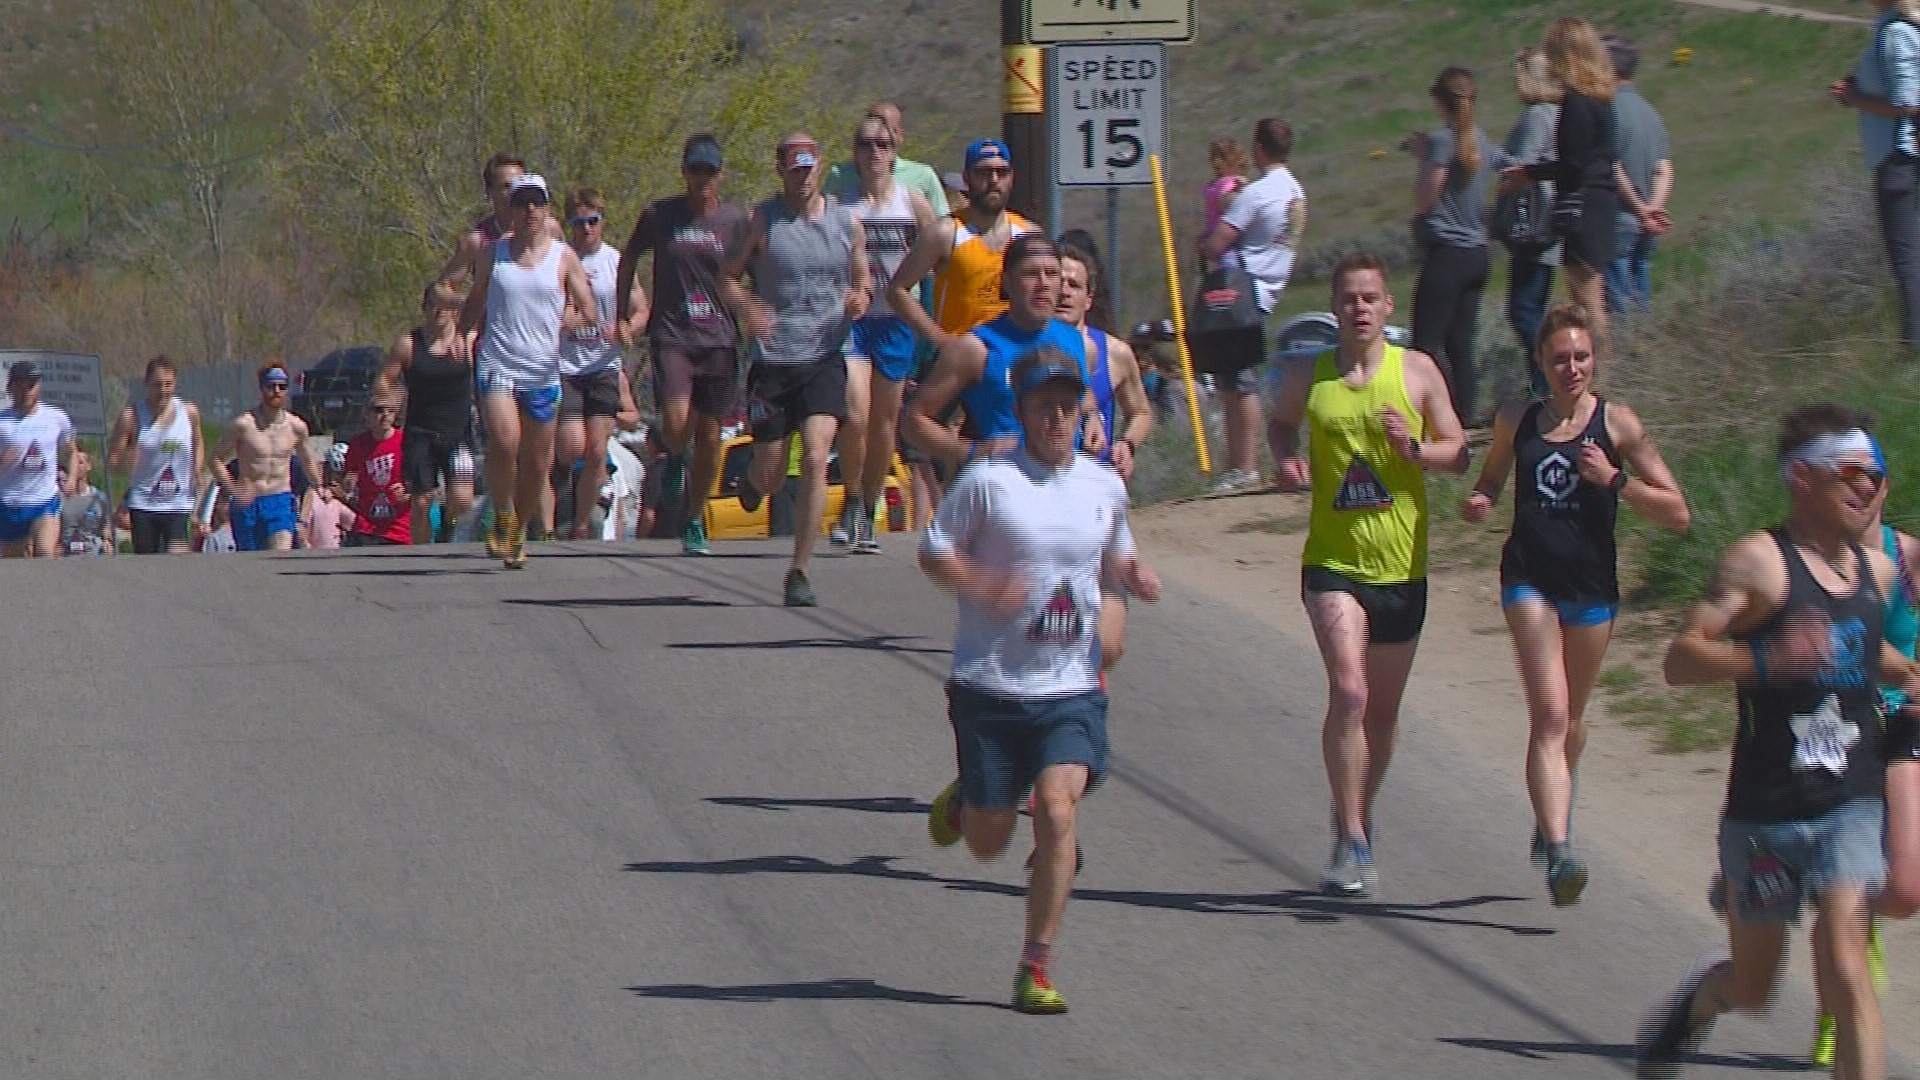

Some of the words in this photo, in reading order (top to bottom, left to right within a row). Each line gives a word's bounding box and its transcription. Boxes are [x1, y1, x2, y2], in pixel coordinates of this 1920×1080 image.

[1064, 60, 1157, 80] SPEED
[1073, 88, 1146, 109] LIMIT
[1076, 119, 1143, 168] 15
